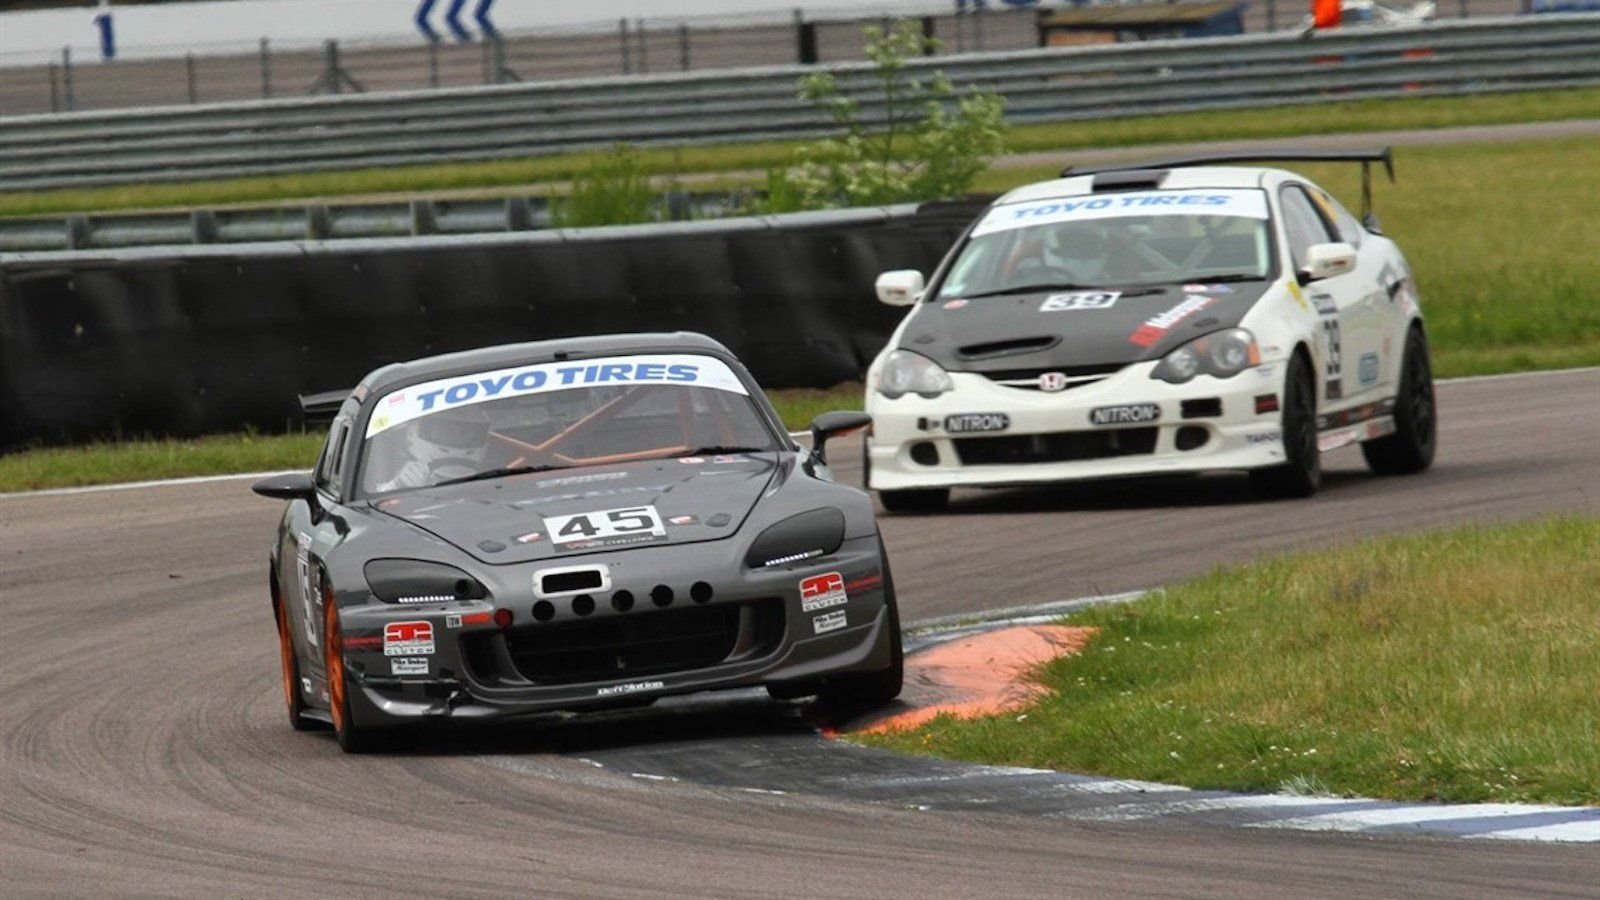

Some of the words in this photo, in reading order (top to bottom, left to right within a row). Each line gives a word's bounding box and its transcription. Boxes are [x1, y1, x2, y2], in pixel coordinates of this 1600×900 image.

[93, 14, 115, 58] 1
[1014, 199, 1113, 219] TOYO
[1121, 194, 1234, 208] TIRES
[1048, 293, 1113, 309] 39
[417, 370, 548, 412] TOYO
[556, 363, 699, 385] TIRES
[948, 415, 1002, 432] NITRON
[1094, 405, 1154, 423] NITRON
[558, 507, 656, 537] 45
[385, 647, 433, 655] CLUTCH
